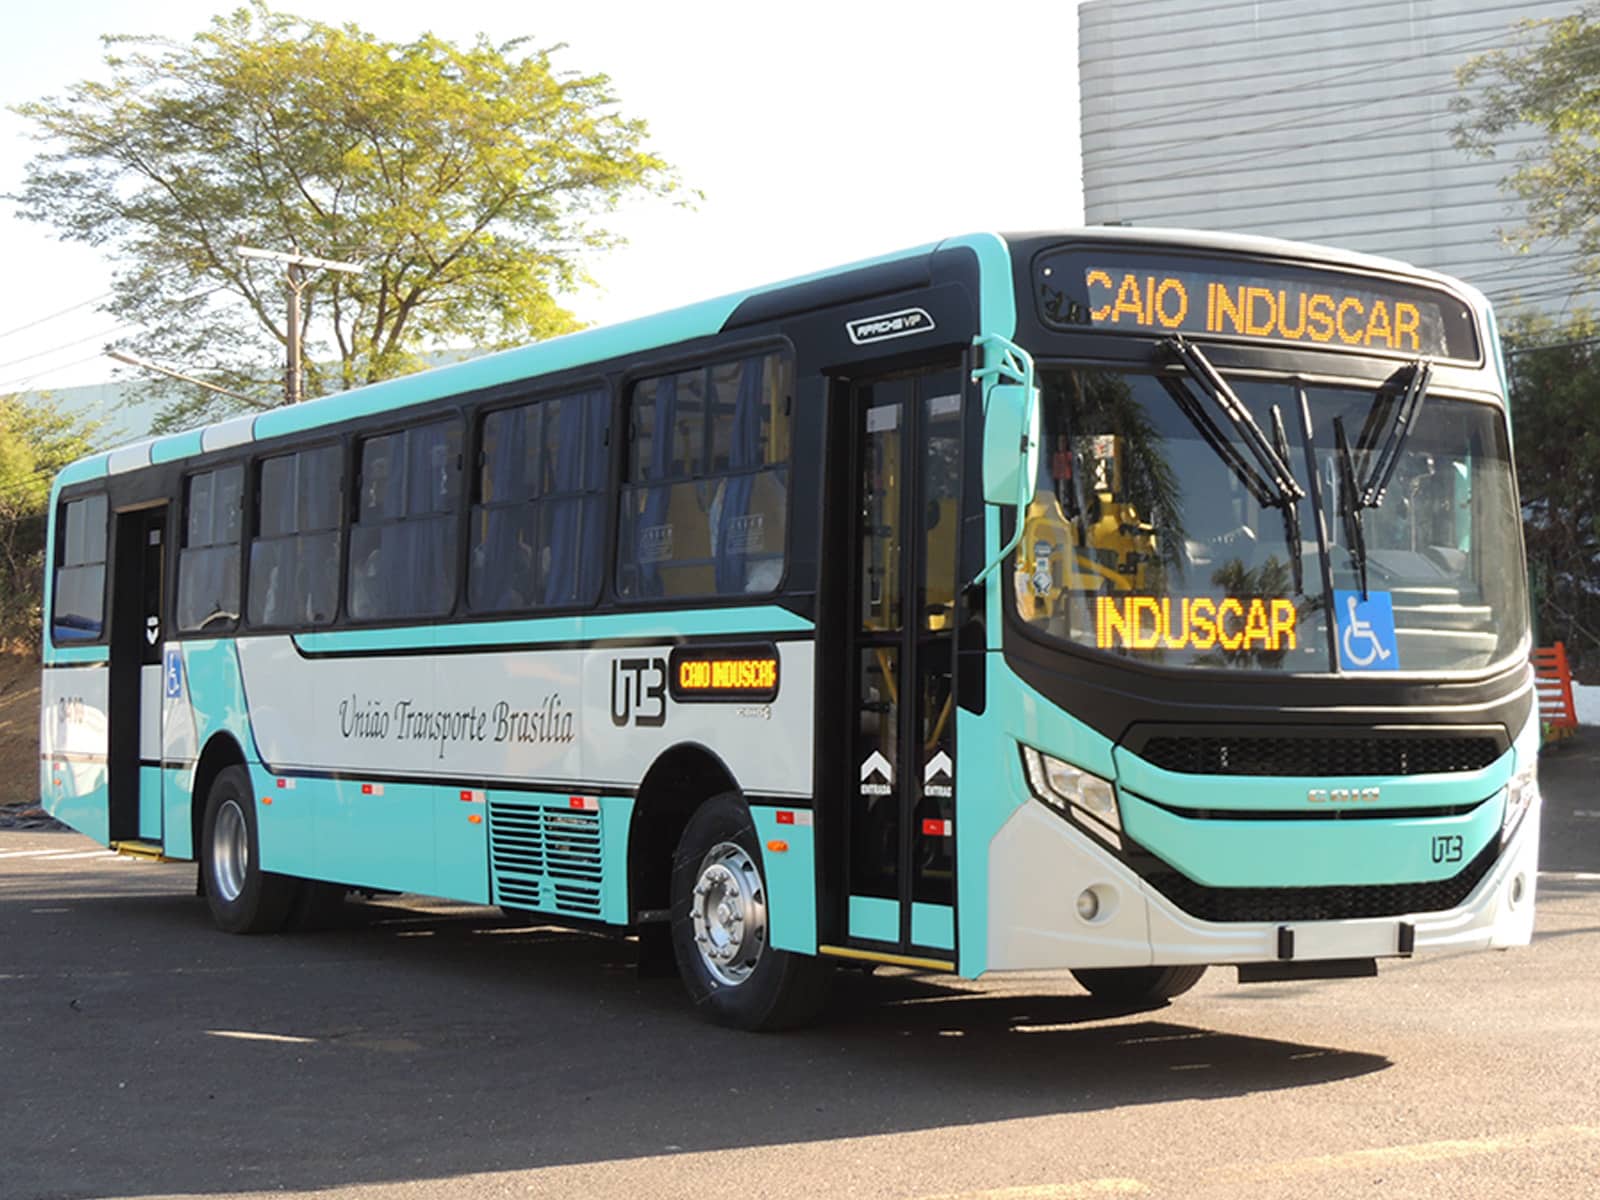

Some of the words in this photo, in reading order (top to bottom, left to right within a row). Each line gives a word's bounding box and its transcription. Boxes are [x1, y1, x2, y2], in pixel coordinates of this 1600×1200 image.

[1086, 270, 1188, 328] CAIO
[1207, 283, 1420, 350] INDUSCAR
[1096, 597, 1296, 650] INDUSCAR
[680, 662, 710, 688] CAIO
[339, 693, 389, 739] União
[394, 698, 487, 759] Transporte
[492, 692, 574, 743] Brasília
